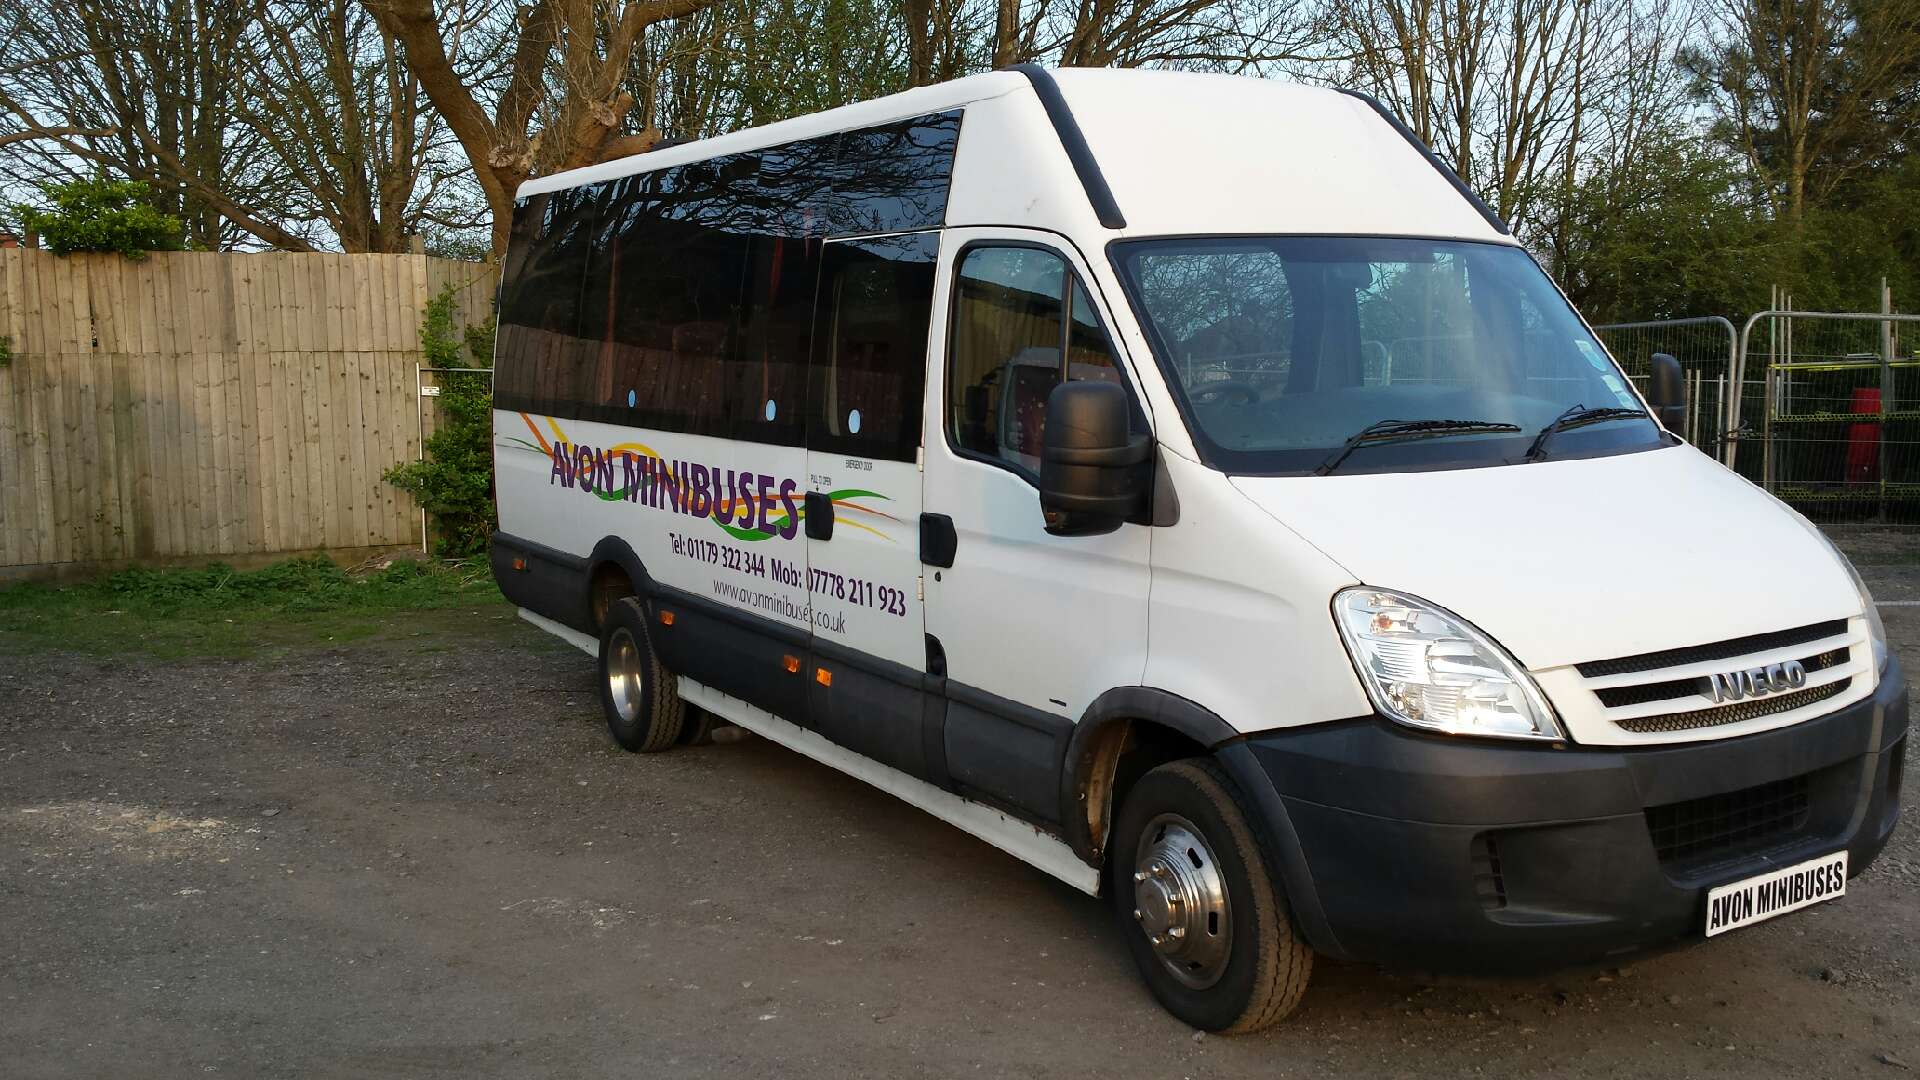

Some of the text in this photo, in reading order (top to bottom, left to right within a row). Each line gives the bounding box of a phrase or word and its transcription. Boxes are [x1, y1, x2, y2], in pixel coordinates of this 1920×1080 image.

[551, 441, 799, 540] AVON MINIBUSES
[669, 532, 906, 617] Tel: 01179 322 344 Mob: 07778 211 923
[713, 579, 846, 634] www.avonminibuses.co.uk
[1707, 659, 1807, 704] IVECO
[1710, 861, 1844, 930] AVON MINIBUSES
